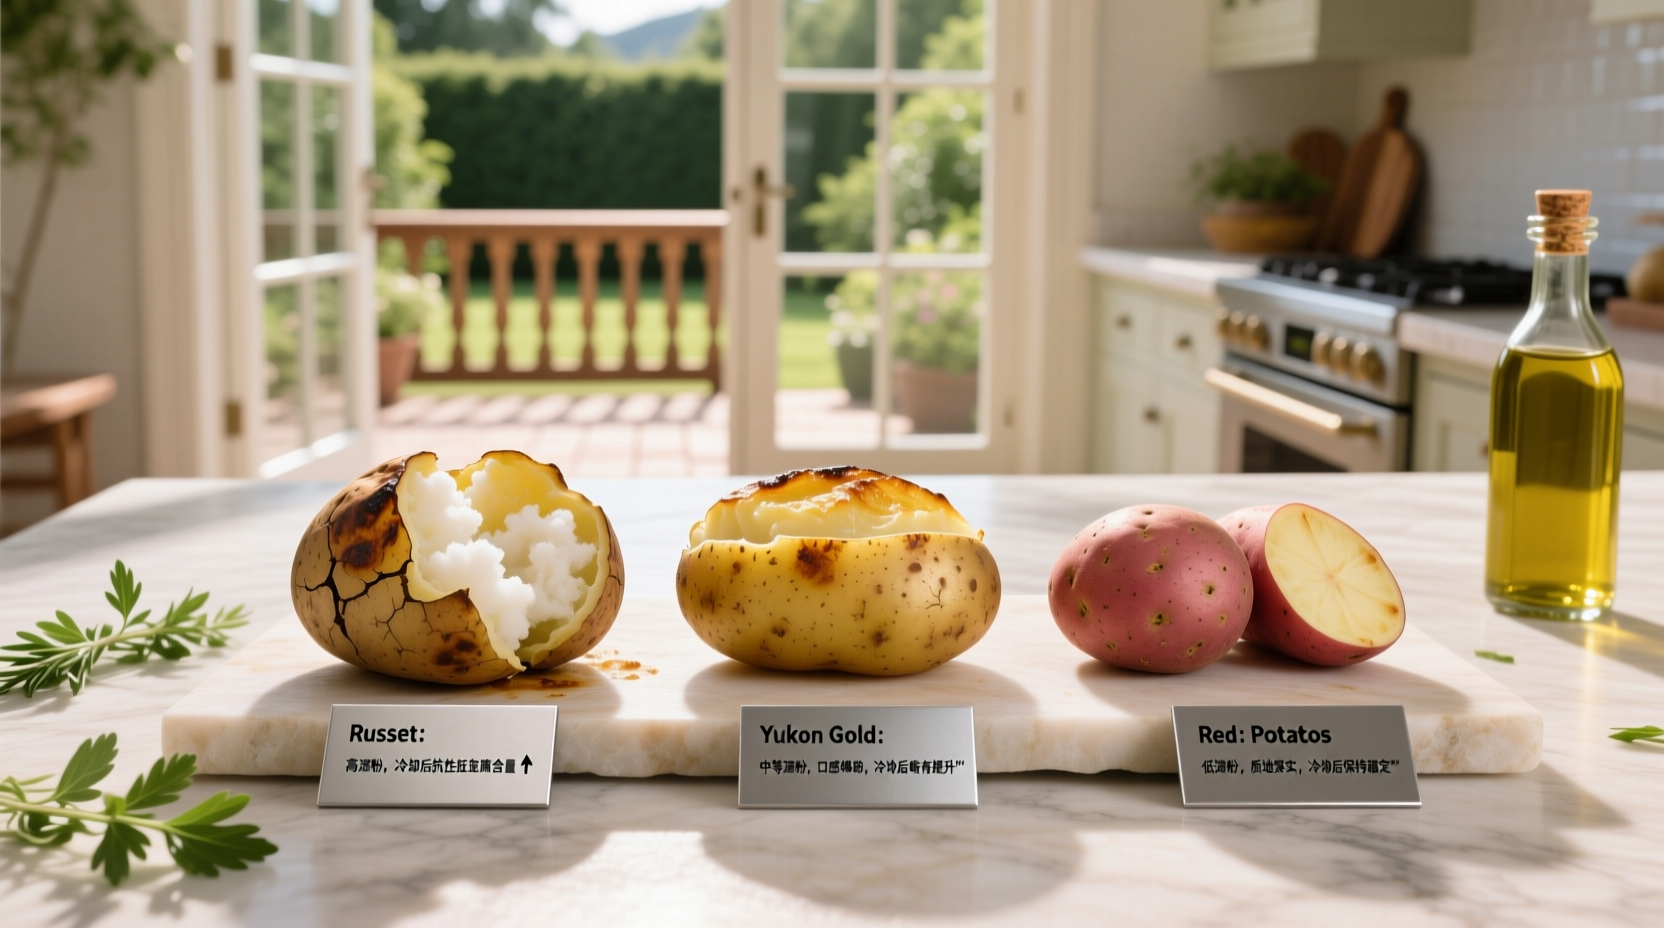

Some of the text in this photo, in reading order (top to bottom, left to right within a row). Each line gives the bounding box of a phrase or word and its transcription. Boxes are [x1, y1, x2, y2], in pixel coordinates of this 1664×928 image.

[350, 724, 424, 742] Russet:
[760, 724, 883, 744] Yukon Gold:
[1199, 725, 1331, 743] Red: Potatos
